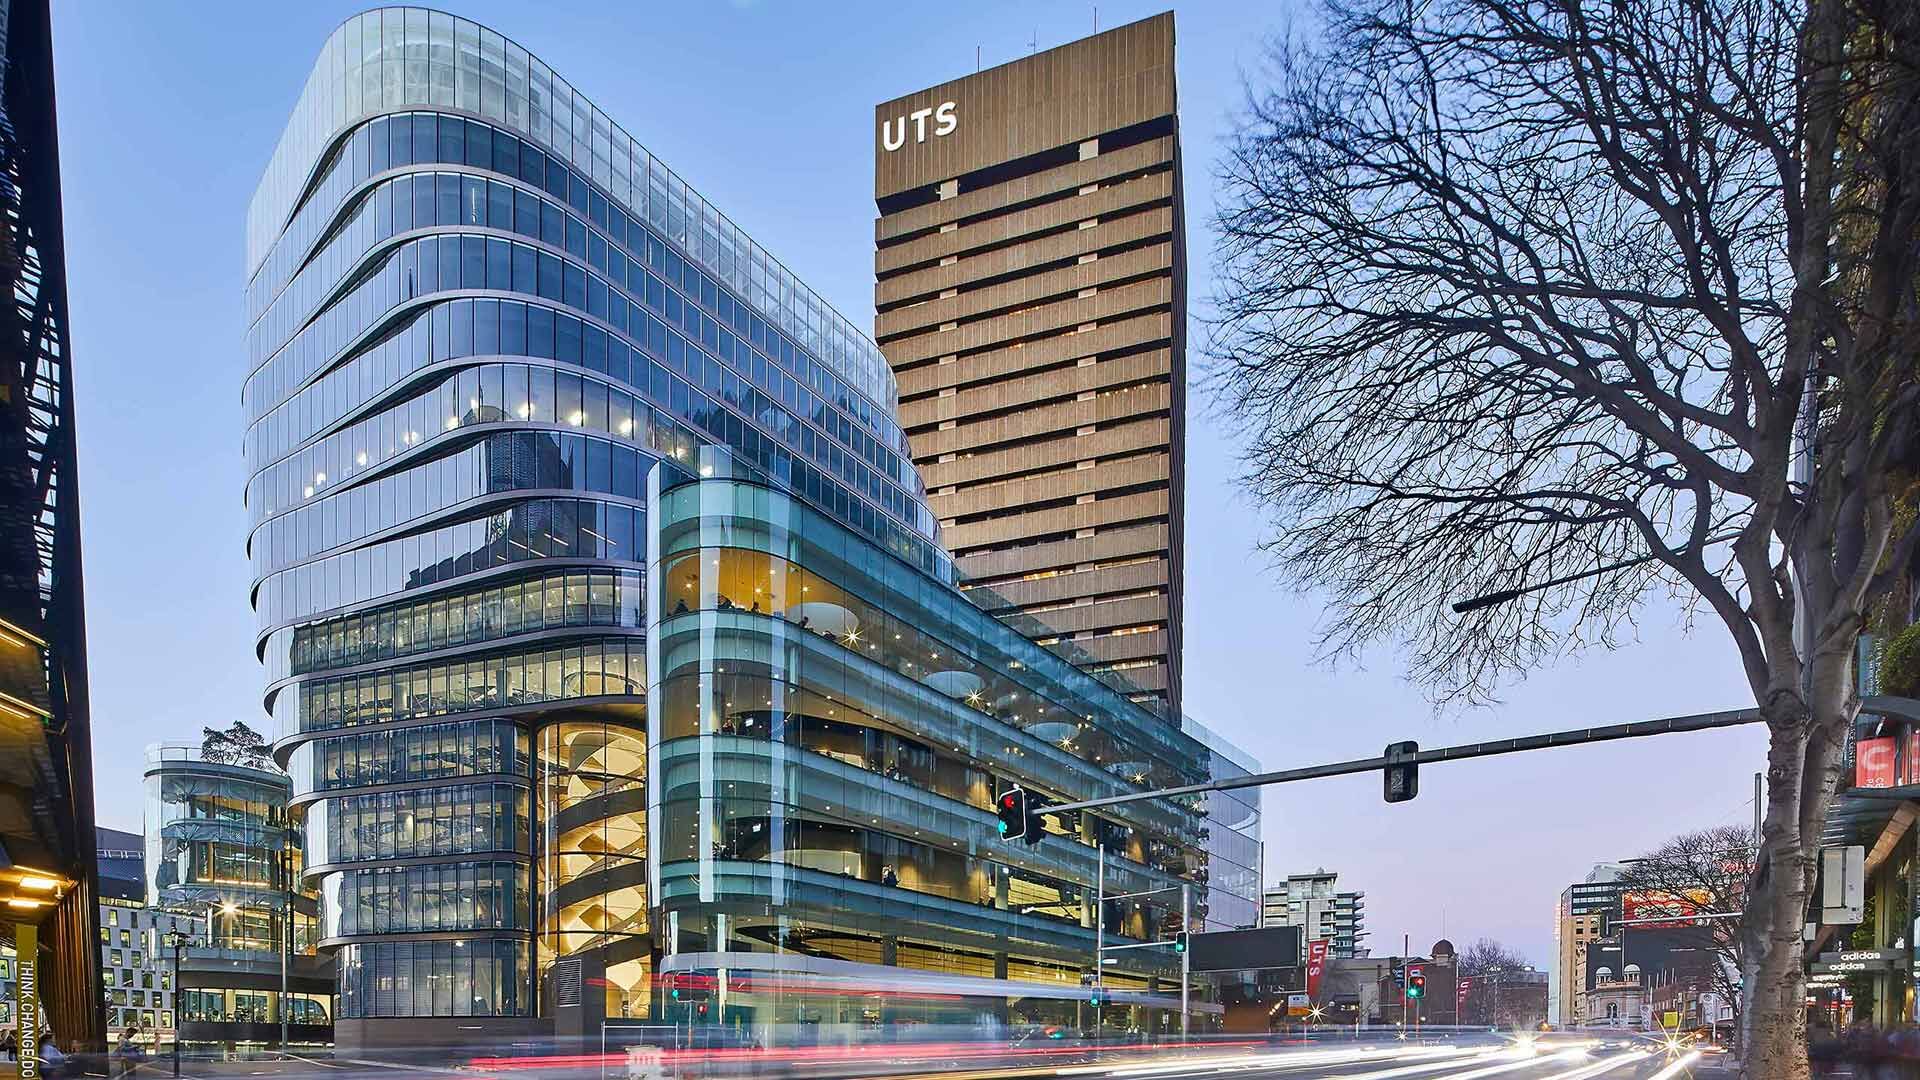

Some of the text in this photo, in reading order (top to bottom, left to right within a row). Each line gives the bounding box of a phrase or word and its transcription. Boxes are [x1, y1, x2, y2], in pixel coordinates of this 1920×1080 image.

[883, 101, 957, 152] UTS
[1309, 944, 1326, 976] UTS
[1829, 962, 1866, 971] adidas
[1840, 952, 1881, 961] adidas
